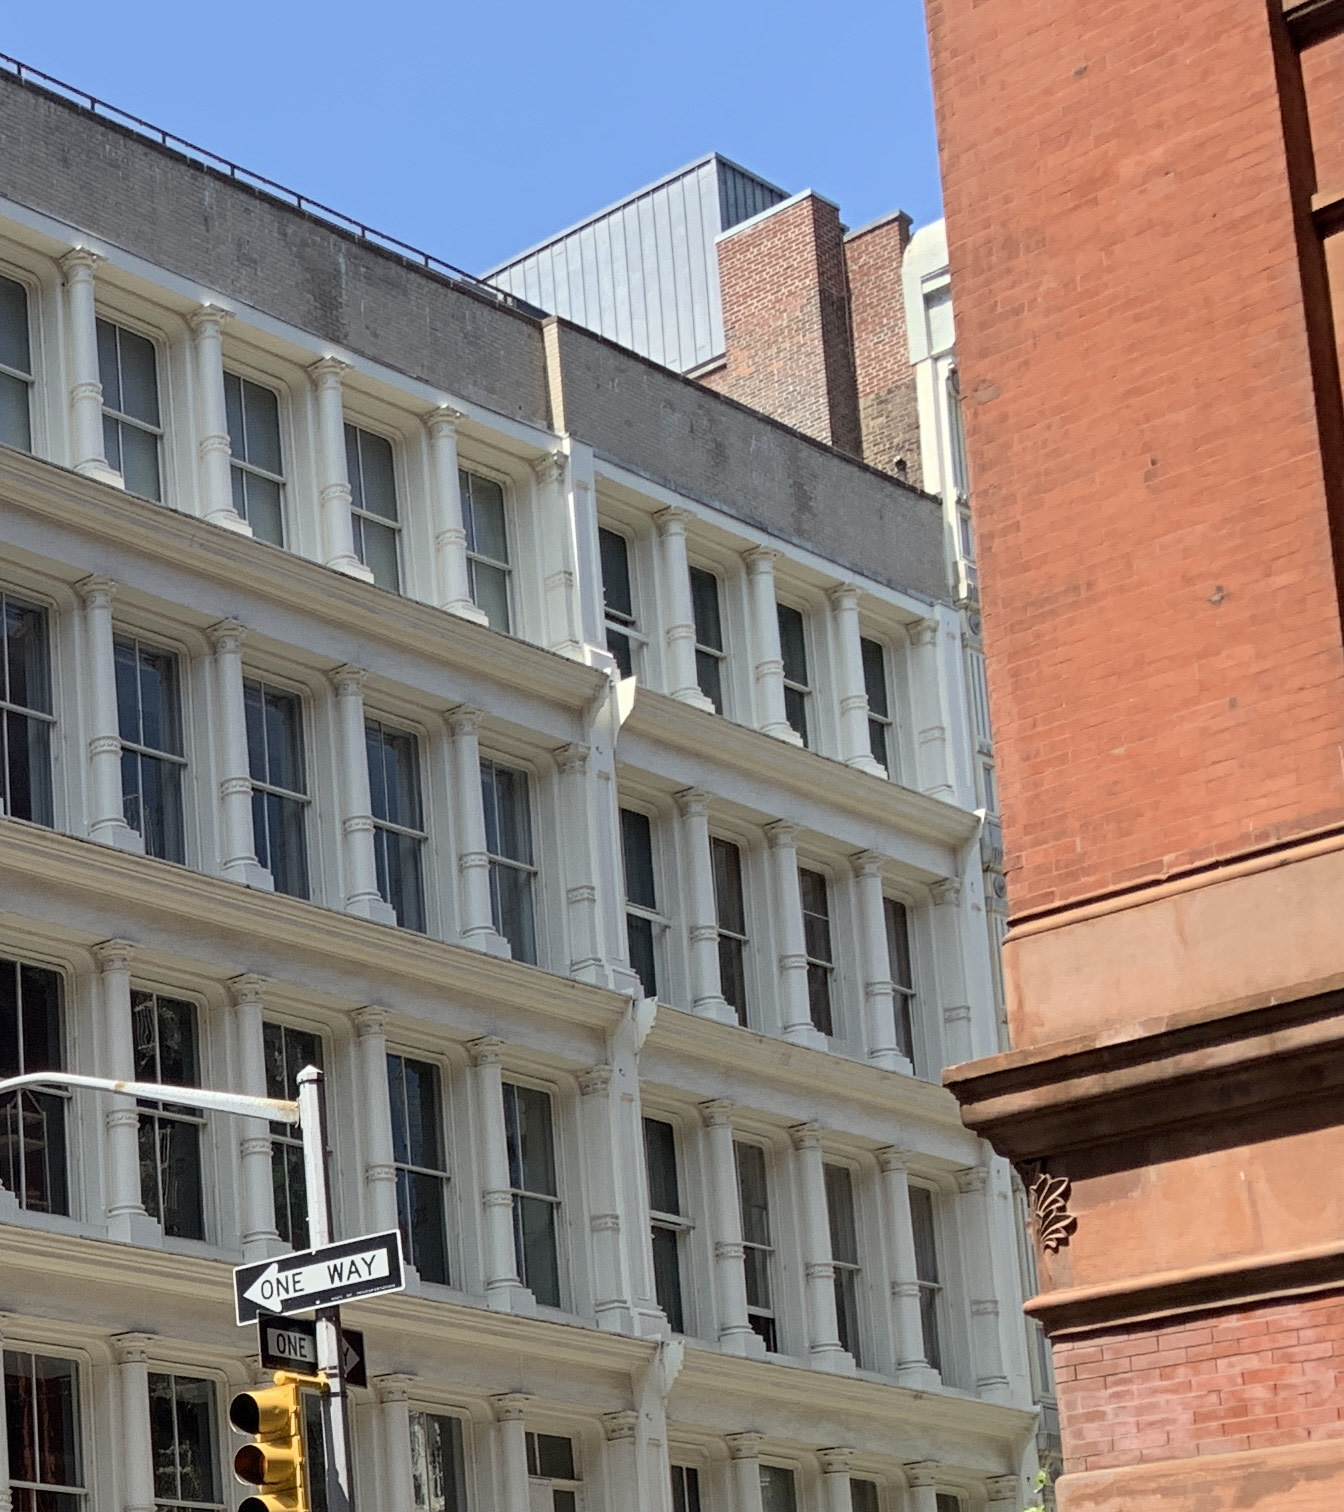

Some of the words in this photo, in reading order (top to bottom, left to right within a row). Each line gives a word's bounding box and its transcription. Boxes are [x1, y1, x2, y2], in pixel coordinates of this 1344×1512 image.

[260, 1272, 305, 1300] ONE
[327, 1254, 376, 1285] WAY
[276, 1332, 308, 1359] ONE
